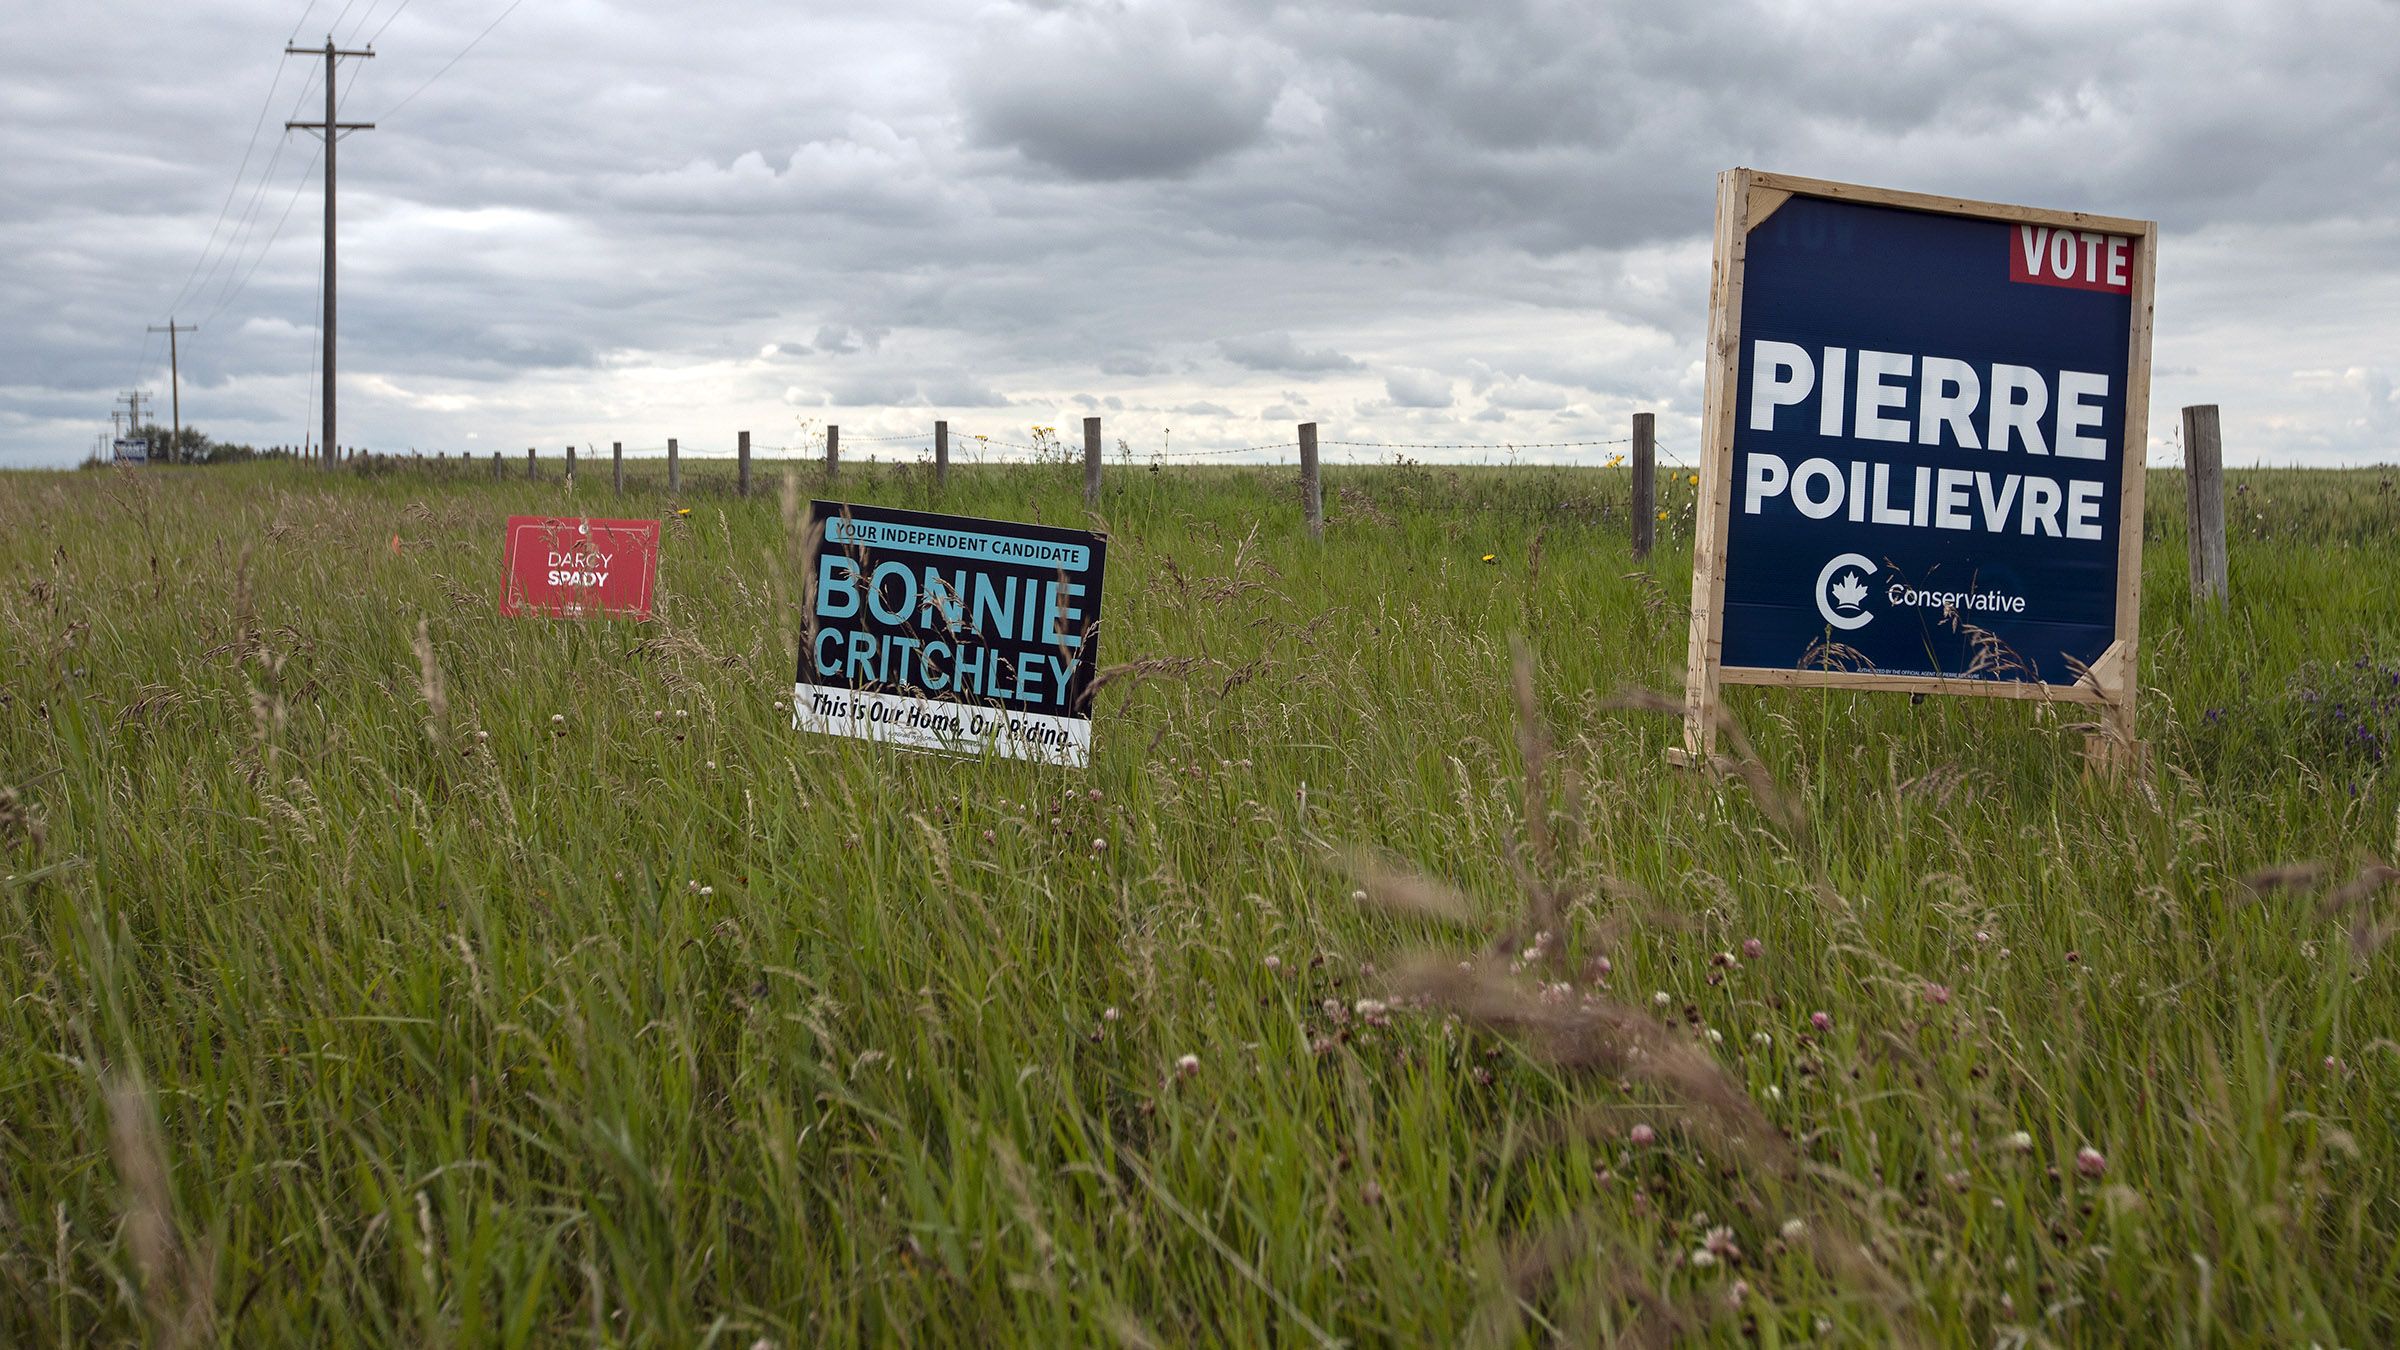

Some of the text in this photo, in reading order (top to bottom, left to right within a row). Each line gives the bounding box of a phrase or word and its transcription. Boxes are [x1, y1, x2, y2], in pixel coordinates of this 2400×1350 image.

[2021, 225, 2127, 286] VOTE
[1750, 340, 2109, 460] PIERRE
[1745, 453, 2104, 540] POILIEVRE
[548, 551, 613, 569] DARCY
[836, 522, 1080, 563] YOUR INDEPENDENT CANDIDATE
[548, 570, 609, 587] SPADY
[1888, 583, 2026, 613] Conservative
[816, 554, 1085, 648] BONNIE
[815, 627, 1080, 706] CRITCHLEY
[1856, 667, 1885, 675] AUTHOIZED
[812, 693, 848, 718] This
[852, 698, 866, 720] is
[870, 701, 904, 723] Our
[906, 705, 965, 737] Home,
